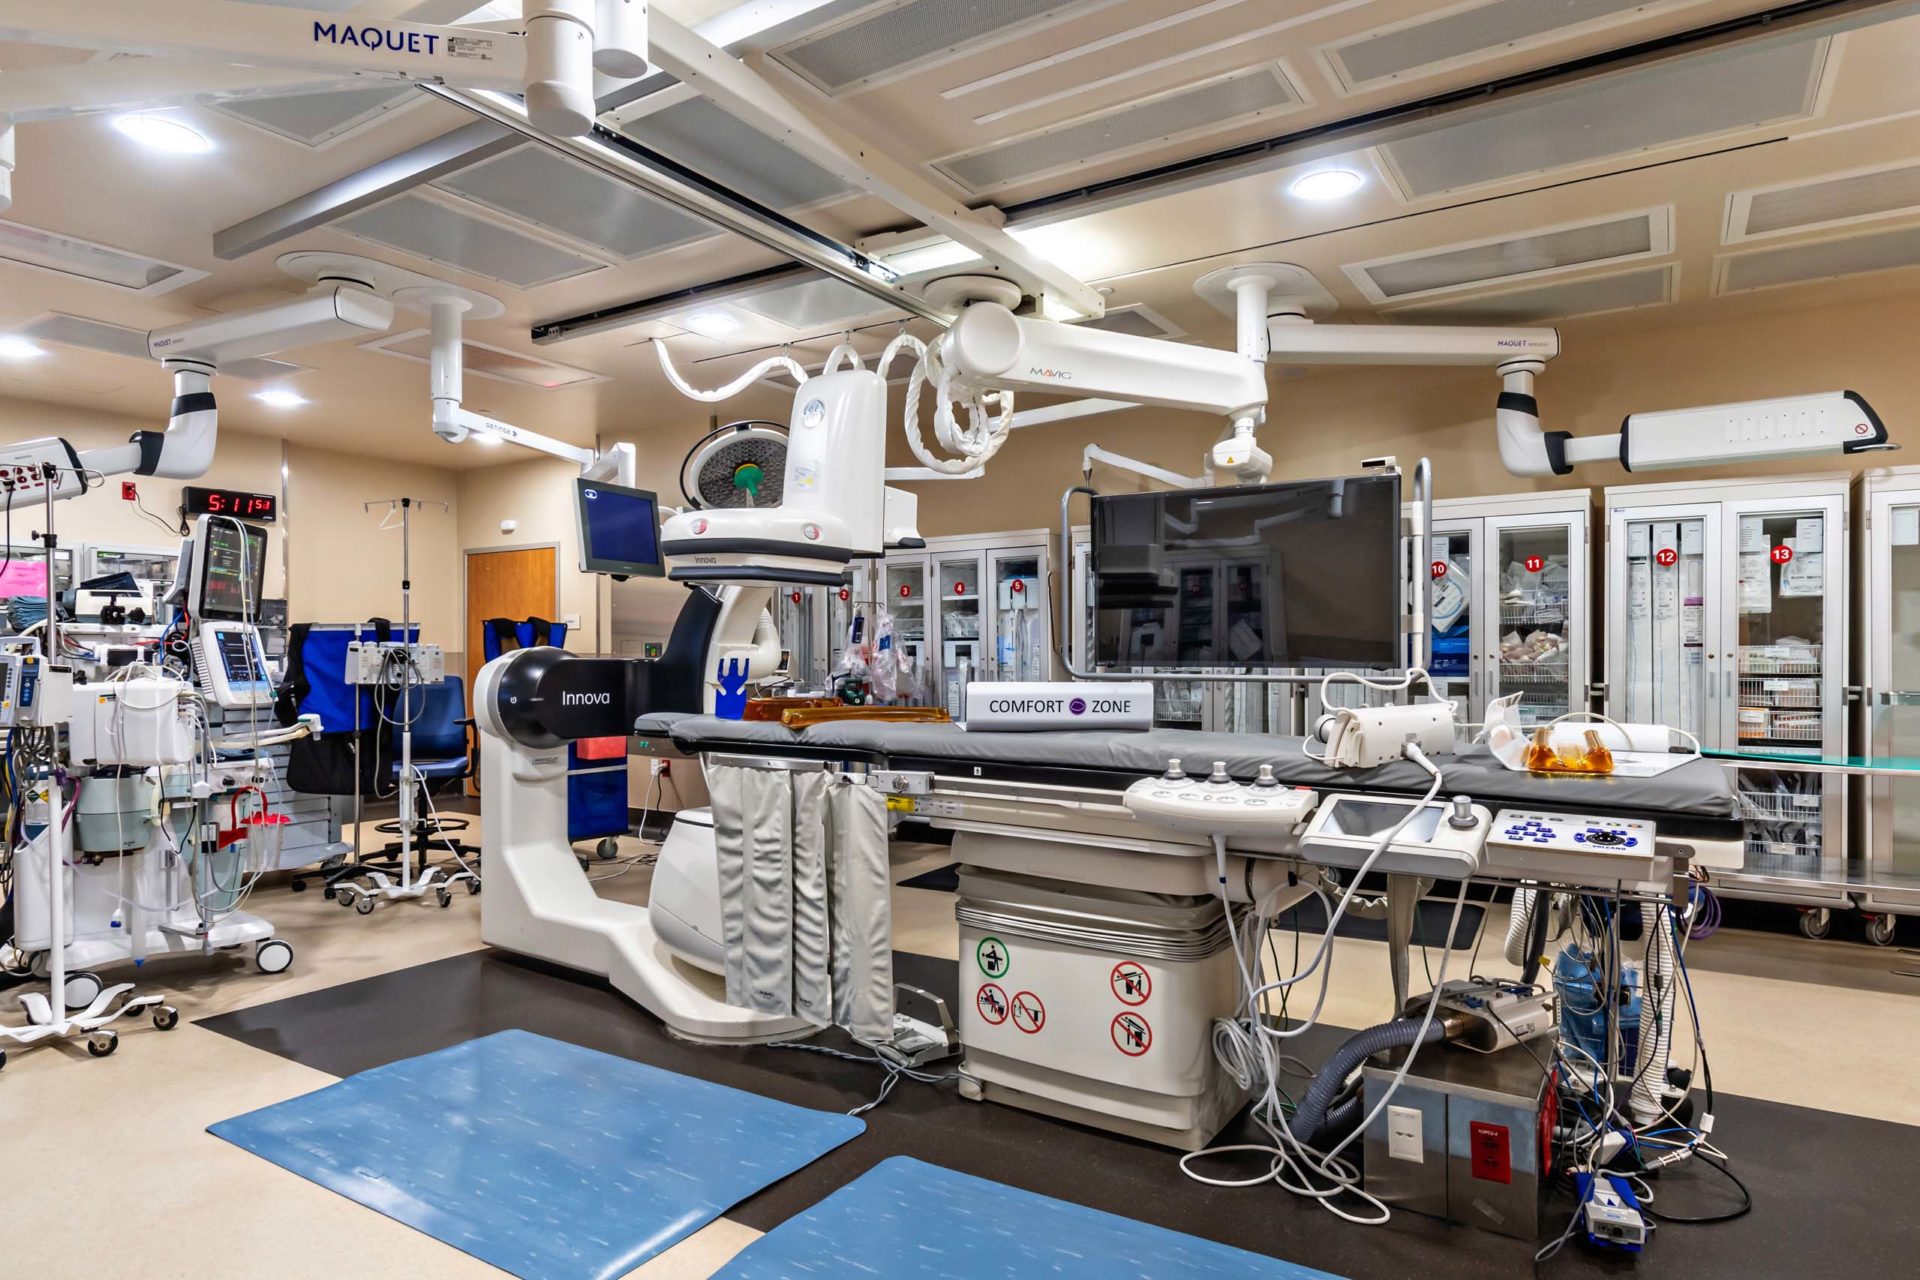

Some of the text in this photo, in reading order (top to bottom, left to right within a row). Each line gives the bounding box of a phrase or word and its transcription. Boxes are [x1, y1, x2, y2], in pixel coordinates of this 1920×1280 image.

[314, 21, 439, 55] MAQUET
[1030, 367, 1072, 380] MAVIG
[1659, 552, 1674, 562] 12
[1772, 549, 1790, 560] 13
[1432, 564, 1445, 574] 10
[1527, 559, 1541, 569] 11
[562, 690, 610, 705] Innova
[989, 700, 1132, 714] COMFORT ZONE
